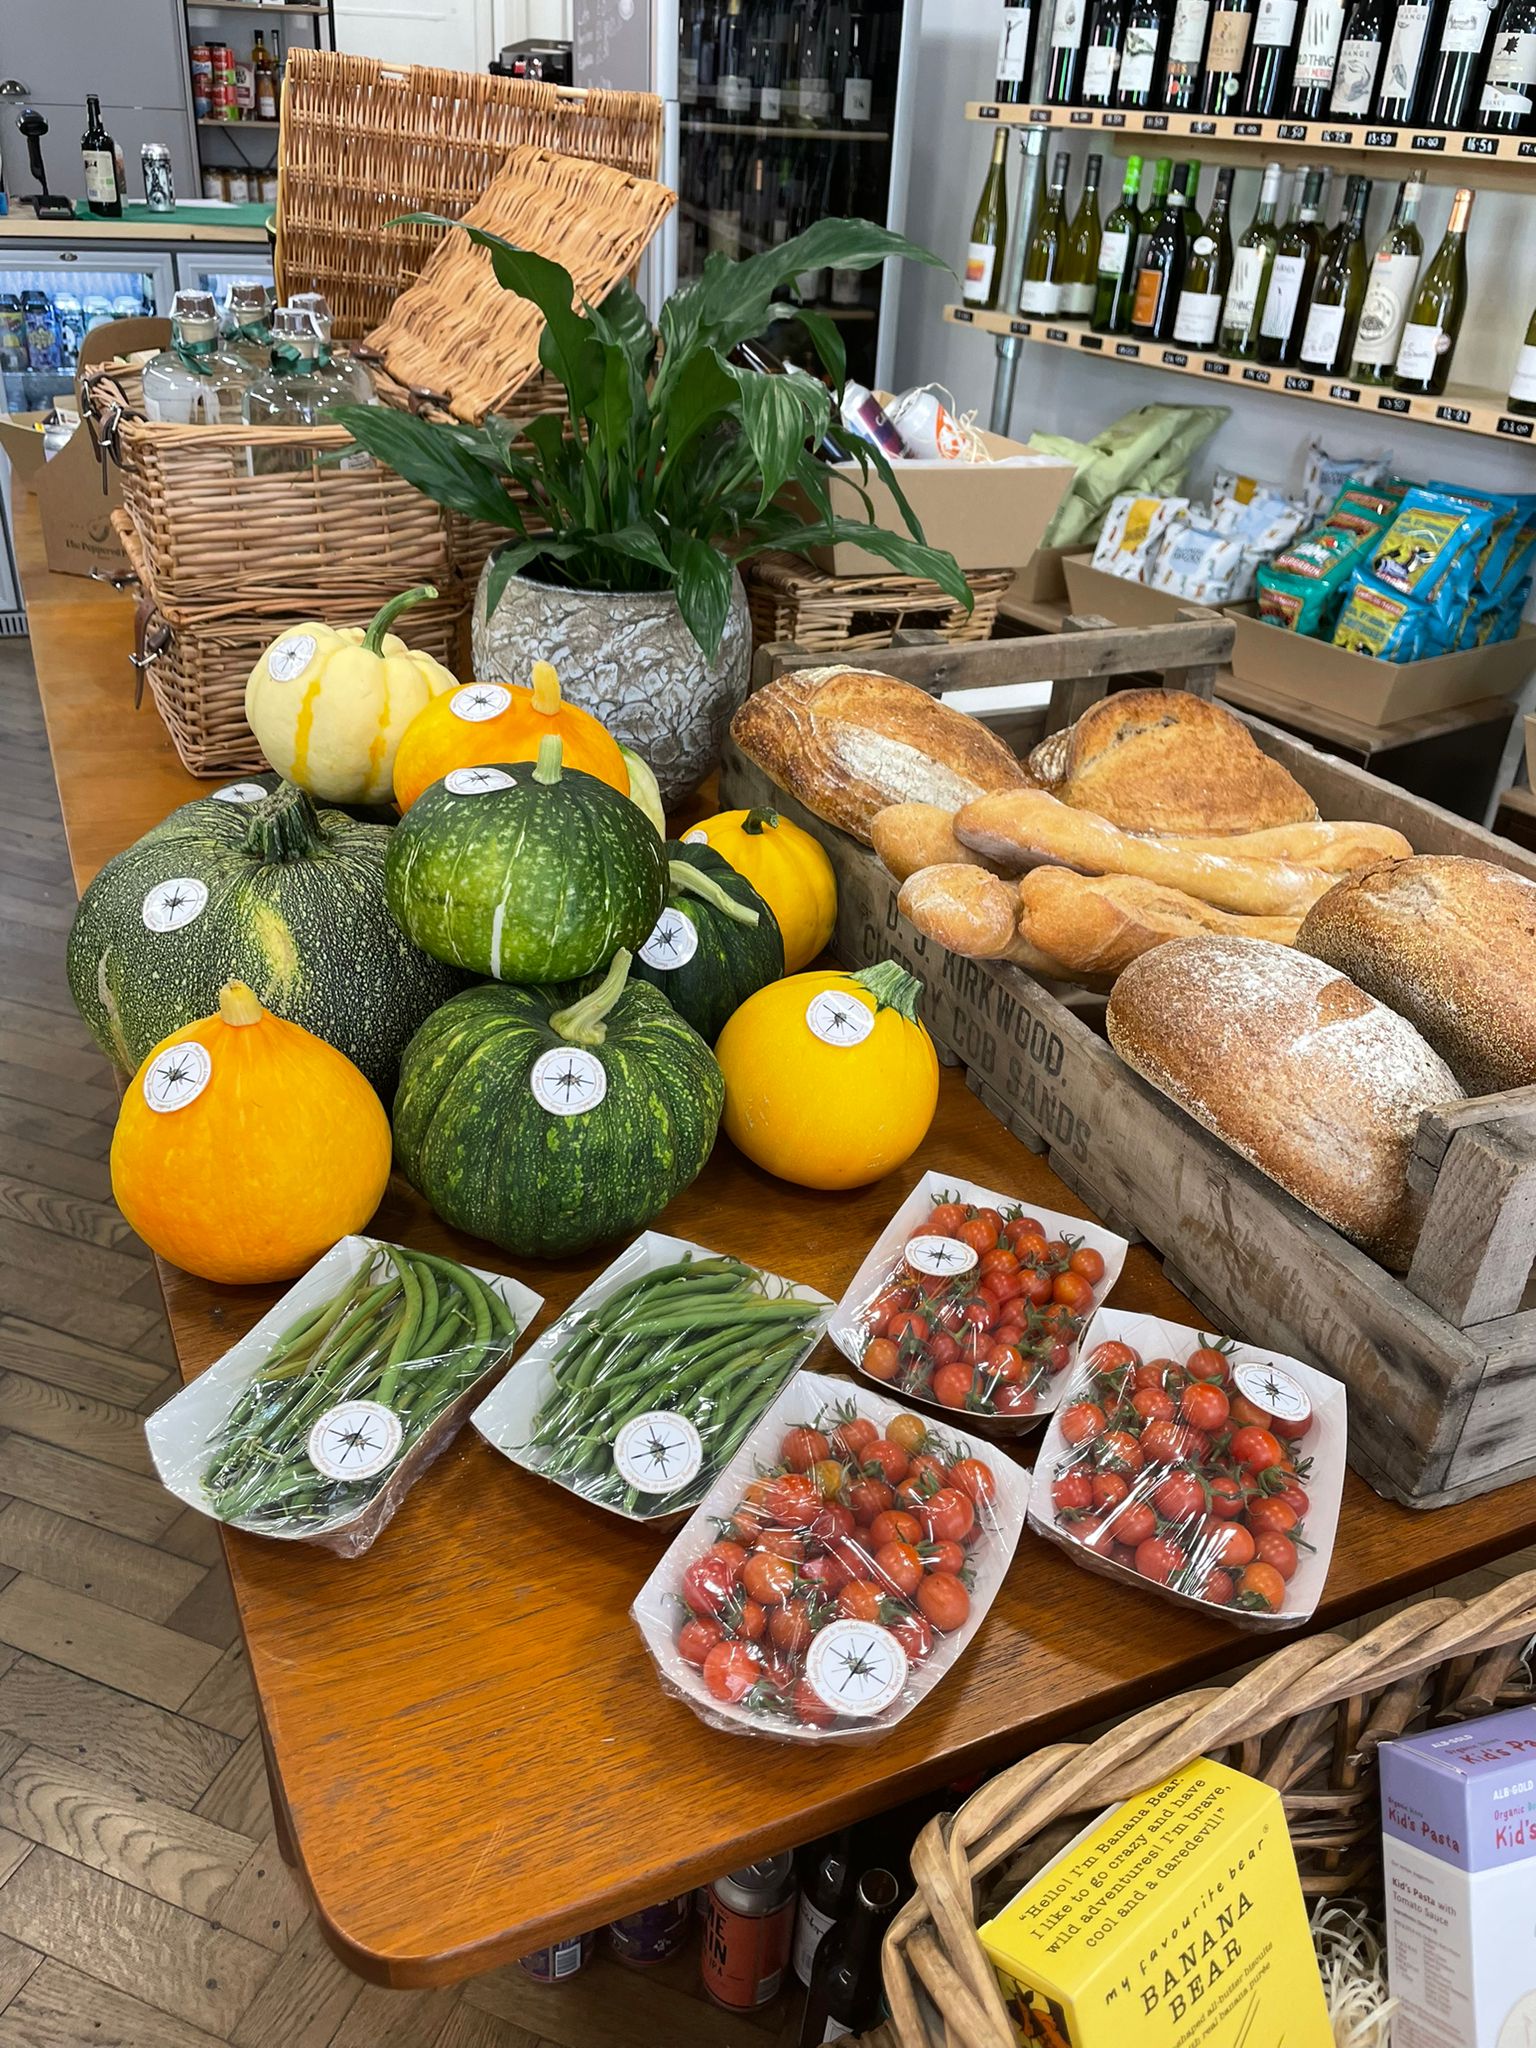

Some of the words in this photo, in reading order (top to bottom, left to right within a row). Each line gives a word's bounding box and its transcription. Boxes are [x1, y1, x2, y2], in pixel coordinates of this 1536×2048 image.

[952, 1006, 997, 1075] COB
[1095, 1809, 1150, 1855] Banana
[1146, 1778, 1184, 1808] Bear.
[1388, 1808, 1416, 1832] Kid's
[1421, 1821, 1460, 1854] Pasta
[1494, 1806, 1525, 1821] Organic
[1495, 1819, 1536, 1849] Kid's
[1030, 1926, 1044, 1941] I
[1043, 1905, 1073, 1931] like
[1071, 1888, 1090, 1904] to
[1090, 1870, 1108, 1890] go
[1108, 1834, 1148, 1870] crazy
[1148, 1809, 1174, 1834] and
[1171, 1778, 1206, 1809] have
[1045, 1923, 1082, 1955] wild
[1080, 1845, 1165, 1924] adventures!
[1184, 1785, 1232, 1822] brave,
[1086, 1919, 1119, 1949] cool
[1117, 1889, 1148, 1919] and
[1145, 1879, 1158, 1891] a
[1105, 1976, 1132, 2006] my
[1138, 1881, 1225, 1976] favourite
[1228, 1838, 1264, 1880] bear
[1392, 1877, 1411, 1893] Kid's
[1413, 1888, 1436, 1906] Pasta
[1437, 1901, 1457, 1917] with
[1393, 1890, 1423, 1913] Tomato
[1424, 1907, 1449, 1927] Sauce
[1140, 1891, 1254, 2016] BANANA
[1168, 1937, 1242, 2024] BEAR
[1207, 1974, 1244, 2017] all-butter
[1244, 1941, 1273, 1976] biscuits
[1219, 1987, 1249, 2021] banana
